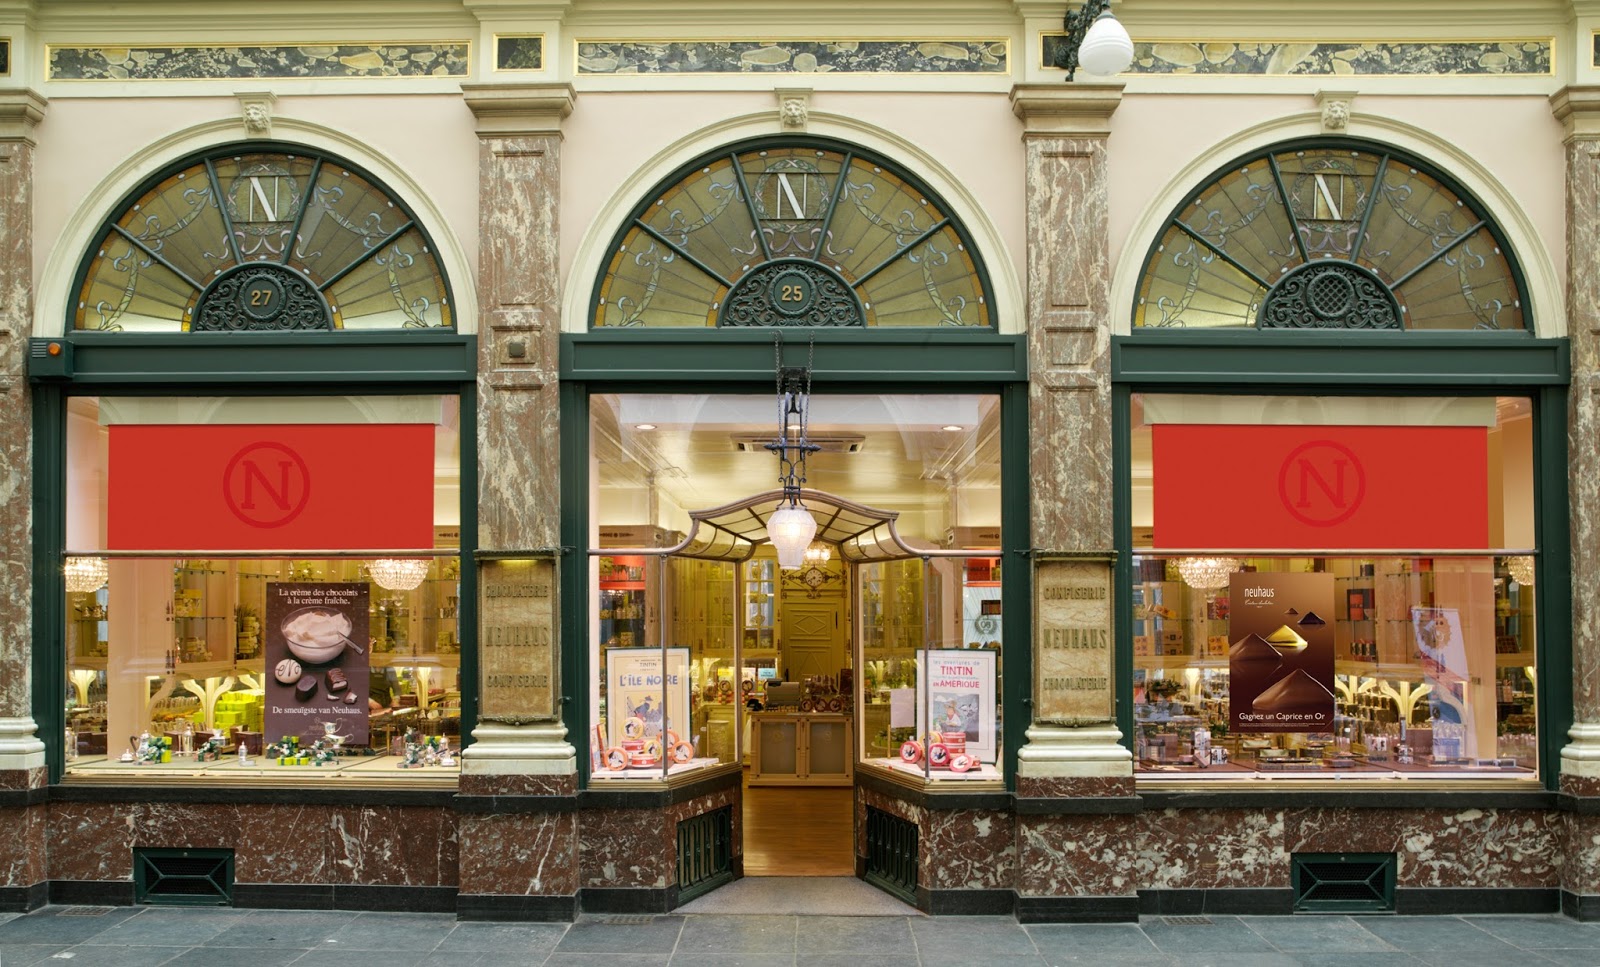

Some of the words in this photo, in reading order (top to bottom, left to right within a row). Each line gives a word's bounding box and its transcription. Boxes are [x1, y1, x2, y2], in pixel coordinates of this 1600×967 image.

[249, 176, 279, 222] N
[777, 173, 807, 219] N
[1313, 174, 1344, 220] N
[251, 290, 272, 306] 27
[781, 285, 803, 301] 25
[241, 460, 293, 510] N
[1296, 459, 1348, 508] N
[279, 588, 289, 596] La
[290, 588, 311, 596] crème
[312, 588, 325, 596] des
[325, 588, 358, 597] chocolats
[486, 584, 548, 598] CHOCOLATERIE
[1044, 586, 1106, 600] CONFISERIE
[1244, 585, 1275, 598] neuhaus
[287, 596, 292, 605] à
[293, 596, 300, 604] la
[301, 597, 323, 605] crème
[486, 626, 549, 647] NEUHAUS
[1043, 628, 1107, 649] NEUHAUS
[940, 665, 973, 676] TINTIN
[487, 674, 548, 688] CONFISERIE
[646, 675, 678, 686] NORE
[1043, 677, 1107, 691] CHOCOLATERIE
[272, 706, 283, 714] De
[332, 706, 362, 714] Neuhaus.
[1239, 712, 1264, 722] Gagnez
[1276, 712, 1303, 722] Caprice
[1314, 712, 1325, 720] Or
